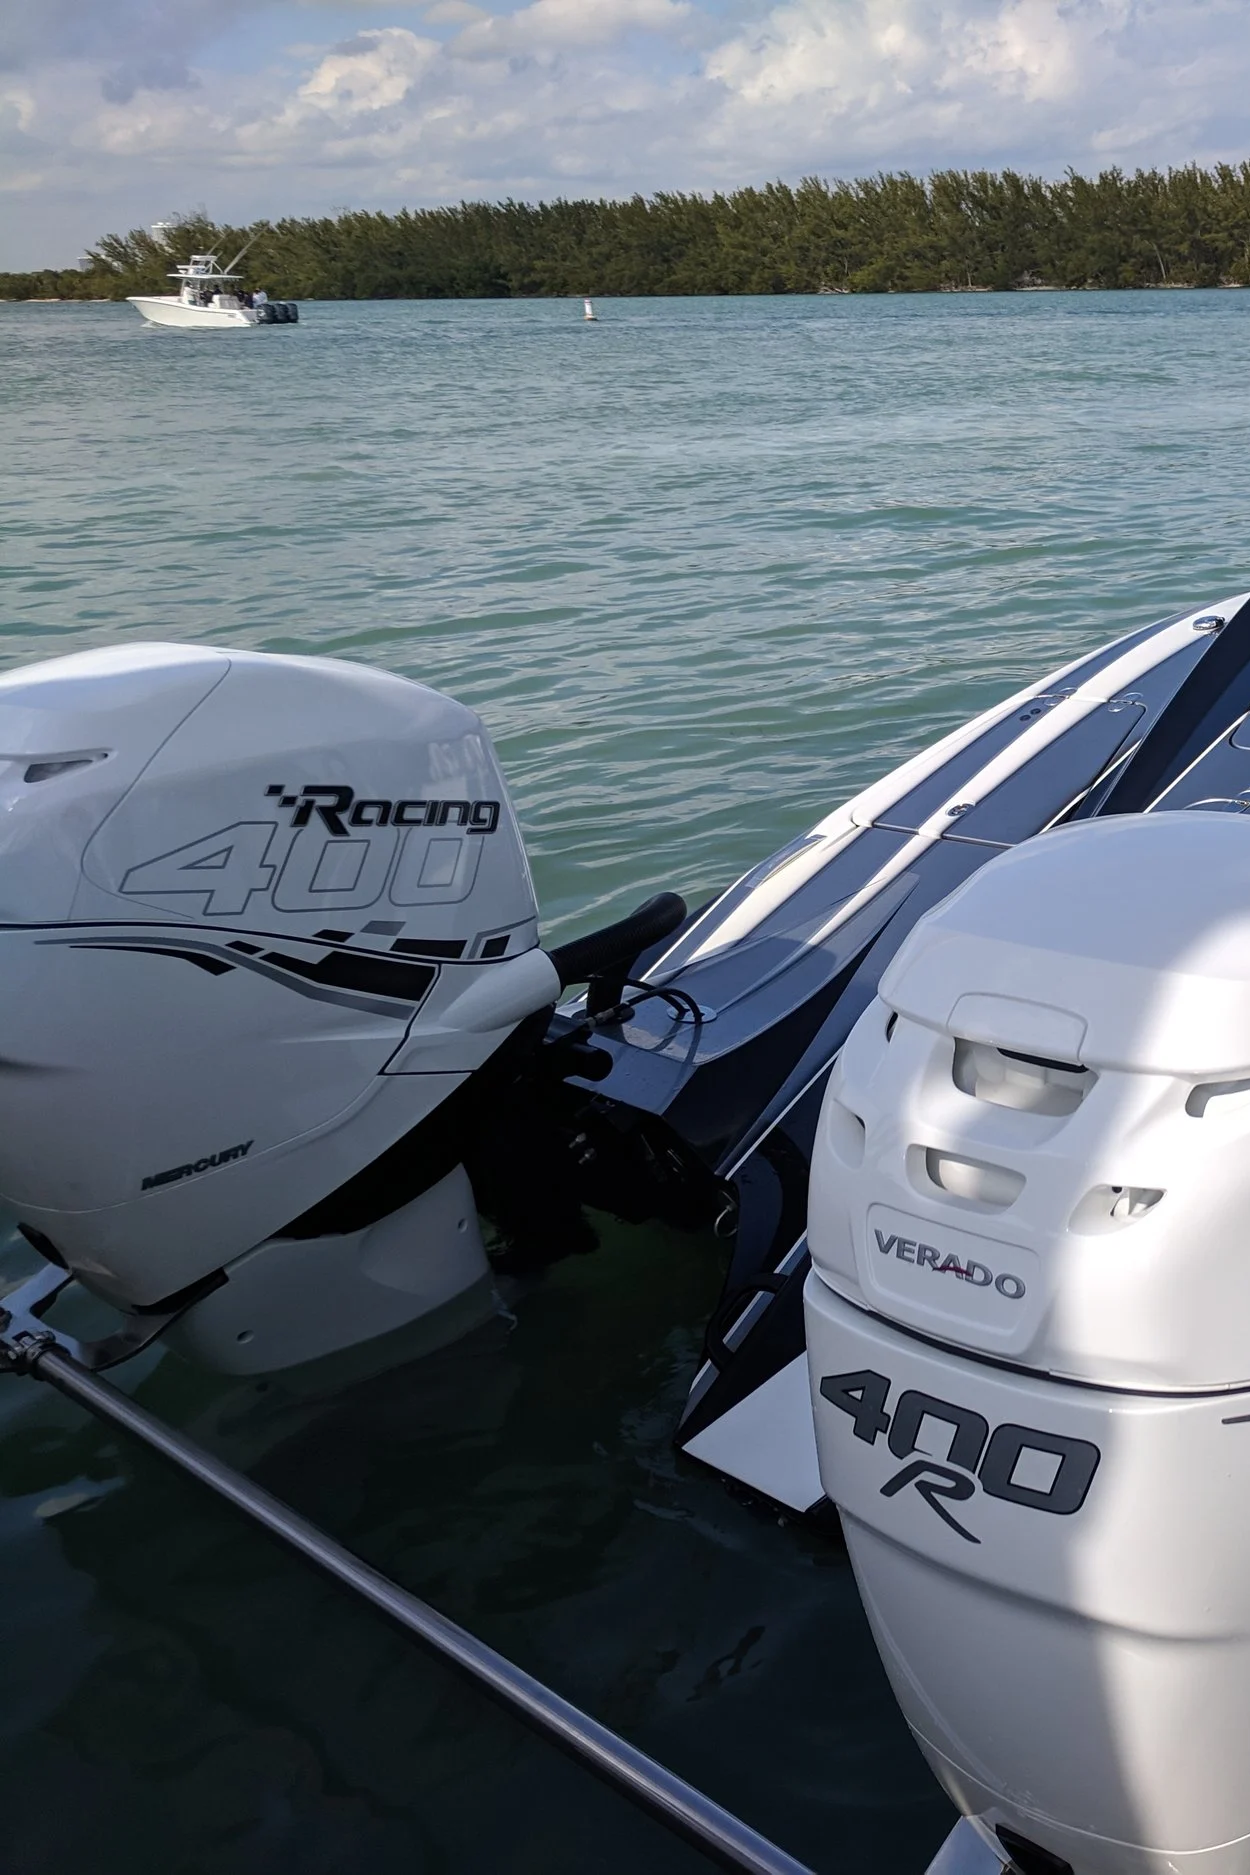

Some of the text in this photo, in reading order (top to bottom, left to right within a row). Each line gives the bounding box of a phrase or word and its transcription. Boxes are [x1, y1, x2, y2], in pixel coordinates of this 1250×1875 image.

[285, 784, 501, 836] Racing
[119, 821, 485, 916] 400
[141, 1139, 254, 1191] MERCURY
[873, 1228, 1027, 1300] VERADO
[820, 1368, 1102, 1516] 400
[880, 1459, 982, 1545] R
